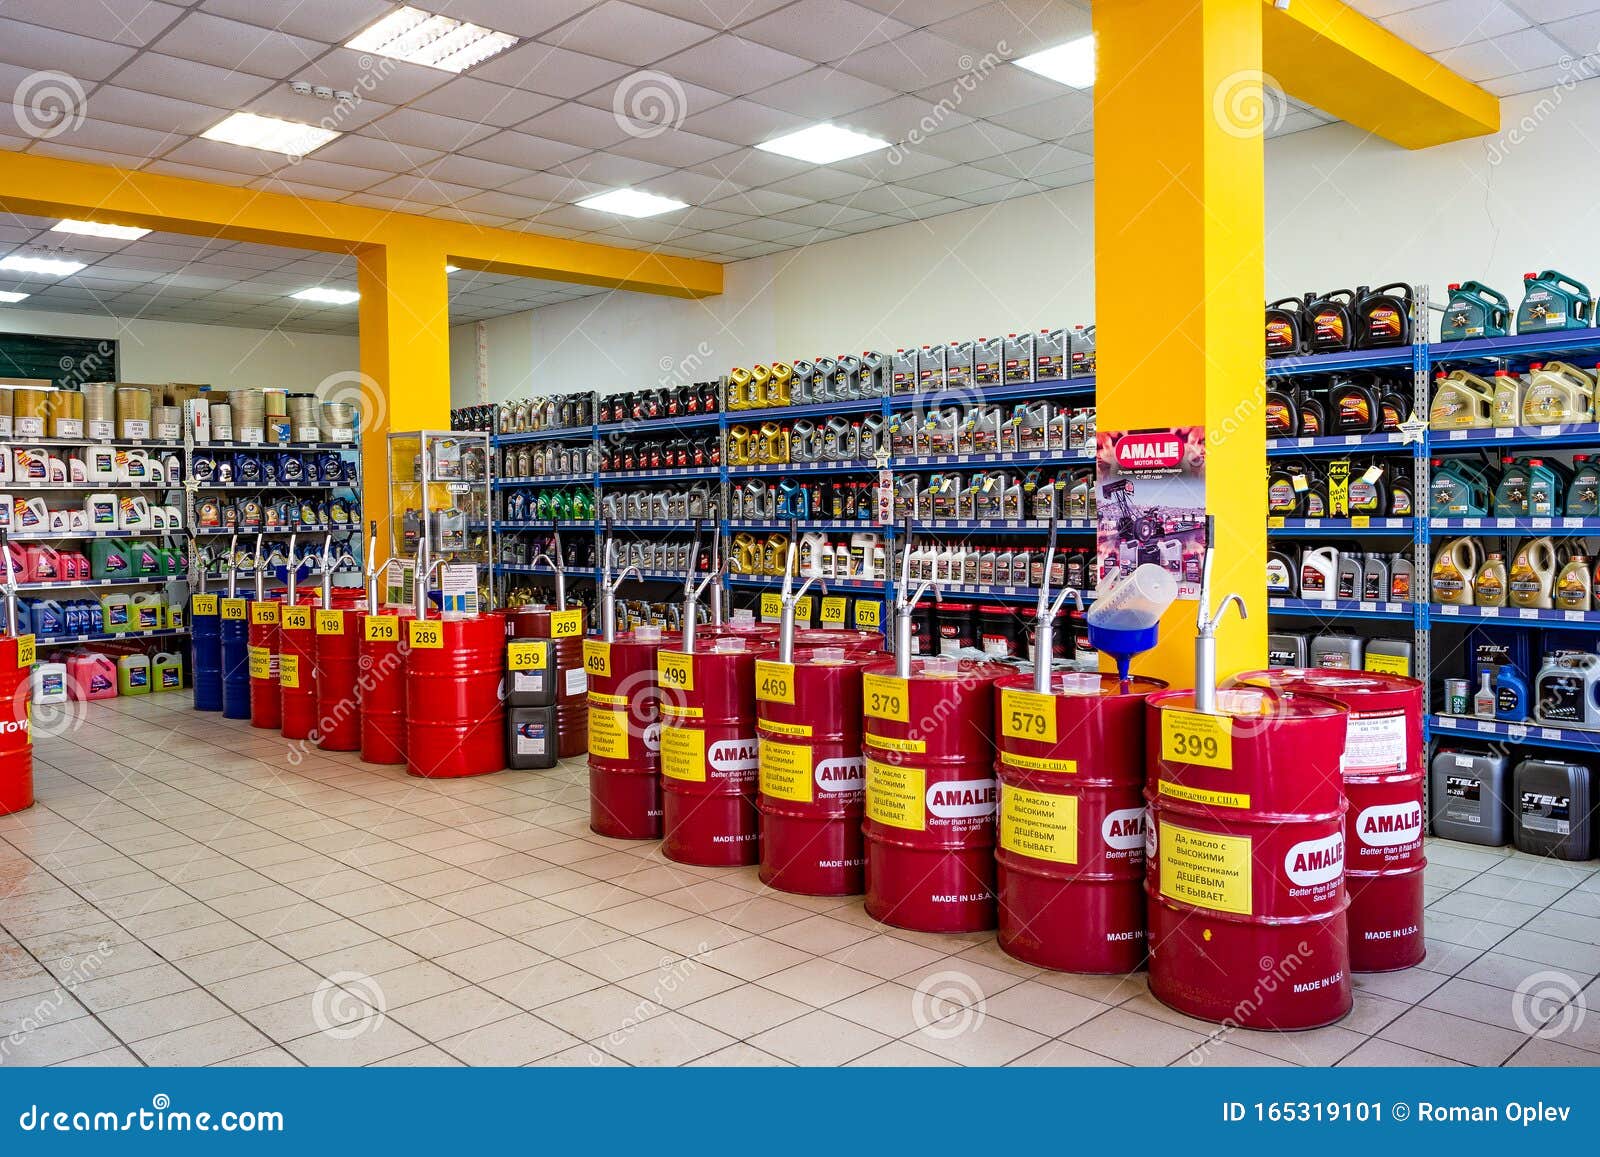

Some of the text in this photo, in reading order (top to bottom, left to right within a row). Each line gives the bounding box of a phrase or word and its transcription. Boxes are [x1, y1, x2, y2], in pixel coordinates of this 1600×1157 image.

[1120, 442, 1179, 459] AMALIE
[196, 603, 213, 612] 179
[226, 607, 242, 617] 199
[764, 603, 778, 614] 259
[825, 607, 841, 619] 329
[257, 611, 275, 622] 159
[287, 615, 305, 626] 149
[860, 610, 875, 622] 679
[321, 620, 339, 631] 199
[556, 621, 577, 634] 269
[371, 626, 393, 638] 219
[415, 631, 437, 644] 289
[1476, 645, 1510, 653] STELS
[515, 652, 540, 665] 359
[588, 655, 606, 672] 499
[663, 666, 687, 685] 499
[762, 678, 787, 697] 469
[871, 693, 900, 715] 379
[1011, 711, 1047, 735] 579
[1173, 732, 1219, 760] 399
[1447, 777, 1481, 787] STELS
[1025, 796, 1049, 807] масло
[1216, 793, 1239, 806] США
[1522, 793, 1570, 808] STELS
[929, 818, 950, 826] Better
[1364, 809, 1420, 834] AMALIE
[1175, 833, 1188, 845] Да,
[1190, 837, 1218, 849] масло
[1105, 851, 1127, 859] Better
[1360, 847, 1383, 856] Better
[1383, 845, 1398, 855] than
[1293, 842, 1343, 873] AMALIE
[1384, 853, 1399, 862] Since
[819, 860, 843, 868] MADE
[1176, 870, 1225, 889] ДЕШЁВЫМ
[1175, 882, 1227, 902] НЕ БЫВАЕТ.
[1289, 887, 1312, 897] Better
[1312, 884, 1326, 895] than
[932, 895, 957, 903] MADE
[959, 894, 968, 902] IN
[1107, 931, 1143, 942] MADE IN
[1364, 930, 1391, 941] MADE
[1392, 929, 1401, 939] IN
[1293, 980, 1321, 993] MADE
[1321, 977, 1329, 987] IN
